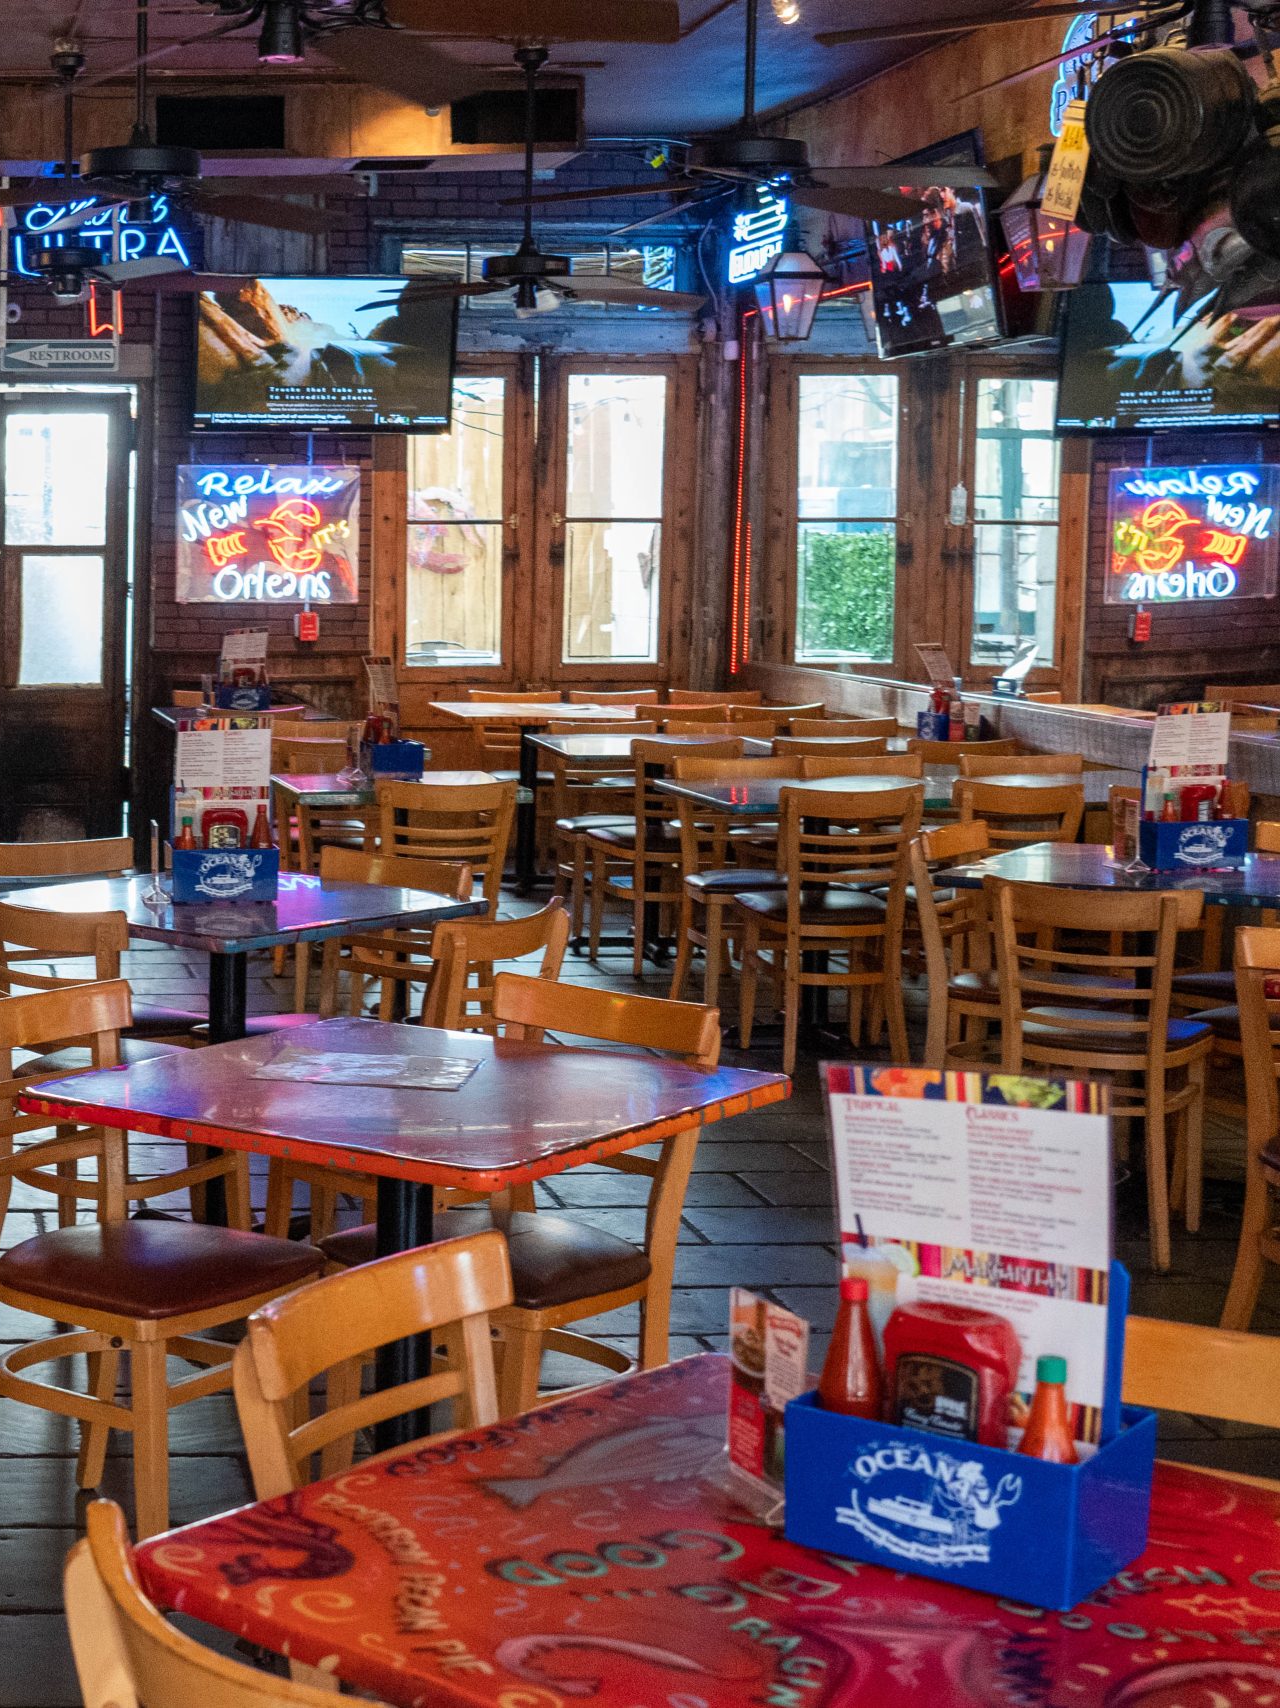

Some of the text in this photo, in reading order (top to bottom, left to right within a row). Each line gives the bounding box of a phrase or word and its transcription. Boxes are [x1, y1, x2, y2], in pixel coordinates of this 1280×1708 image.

[28, 349, 111, 361] RESTROOMS
[196, 469, 344, 497] Relax
[182, 495, 248, 542] New
[213, 561, 331, 600] Orleans
[498, 1529, 744, 1587] GOOD
